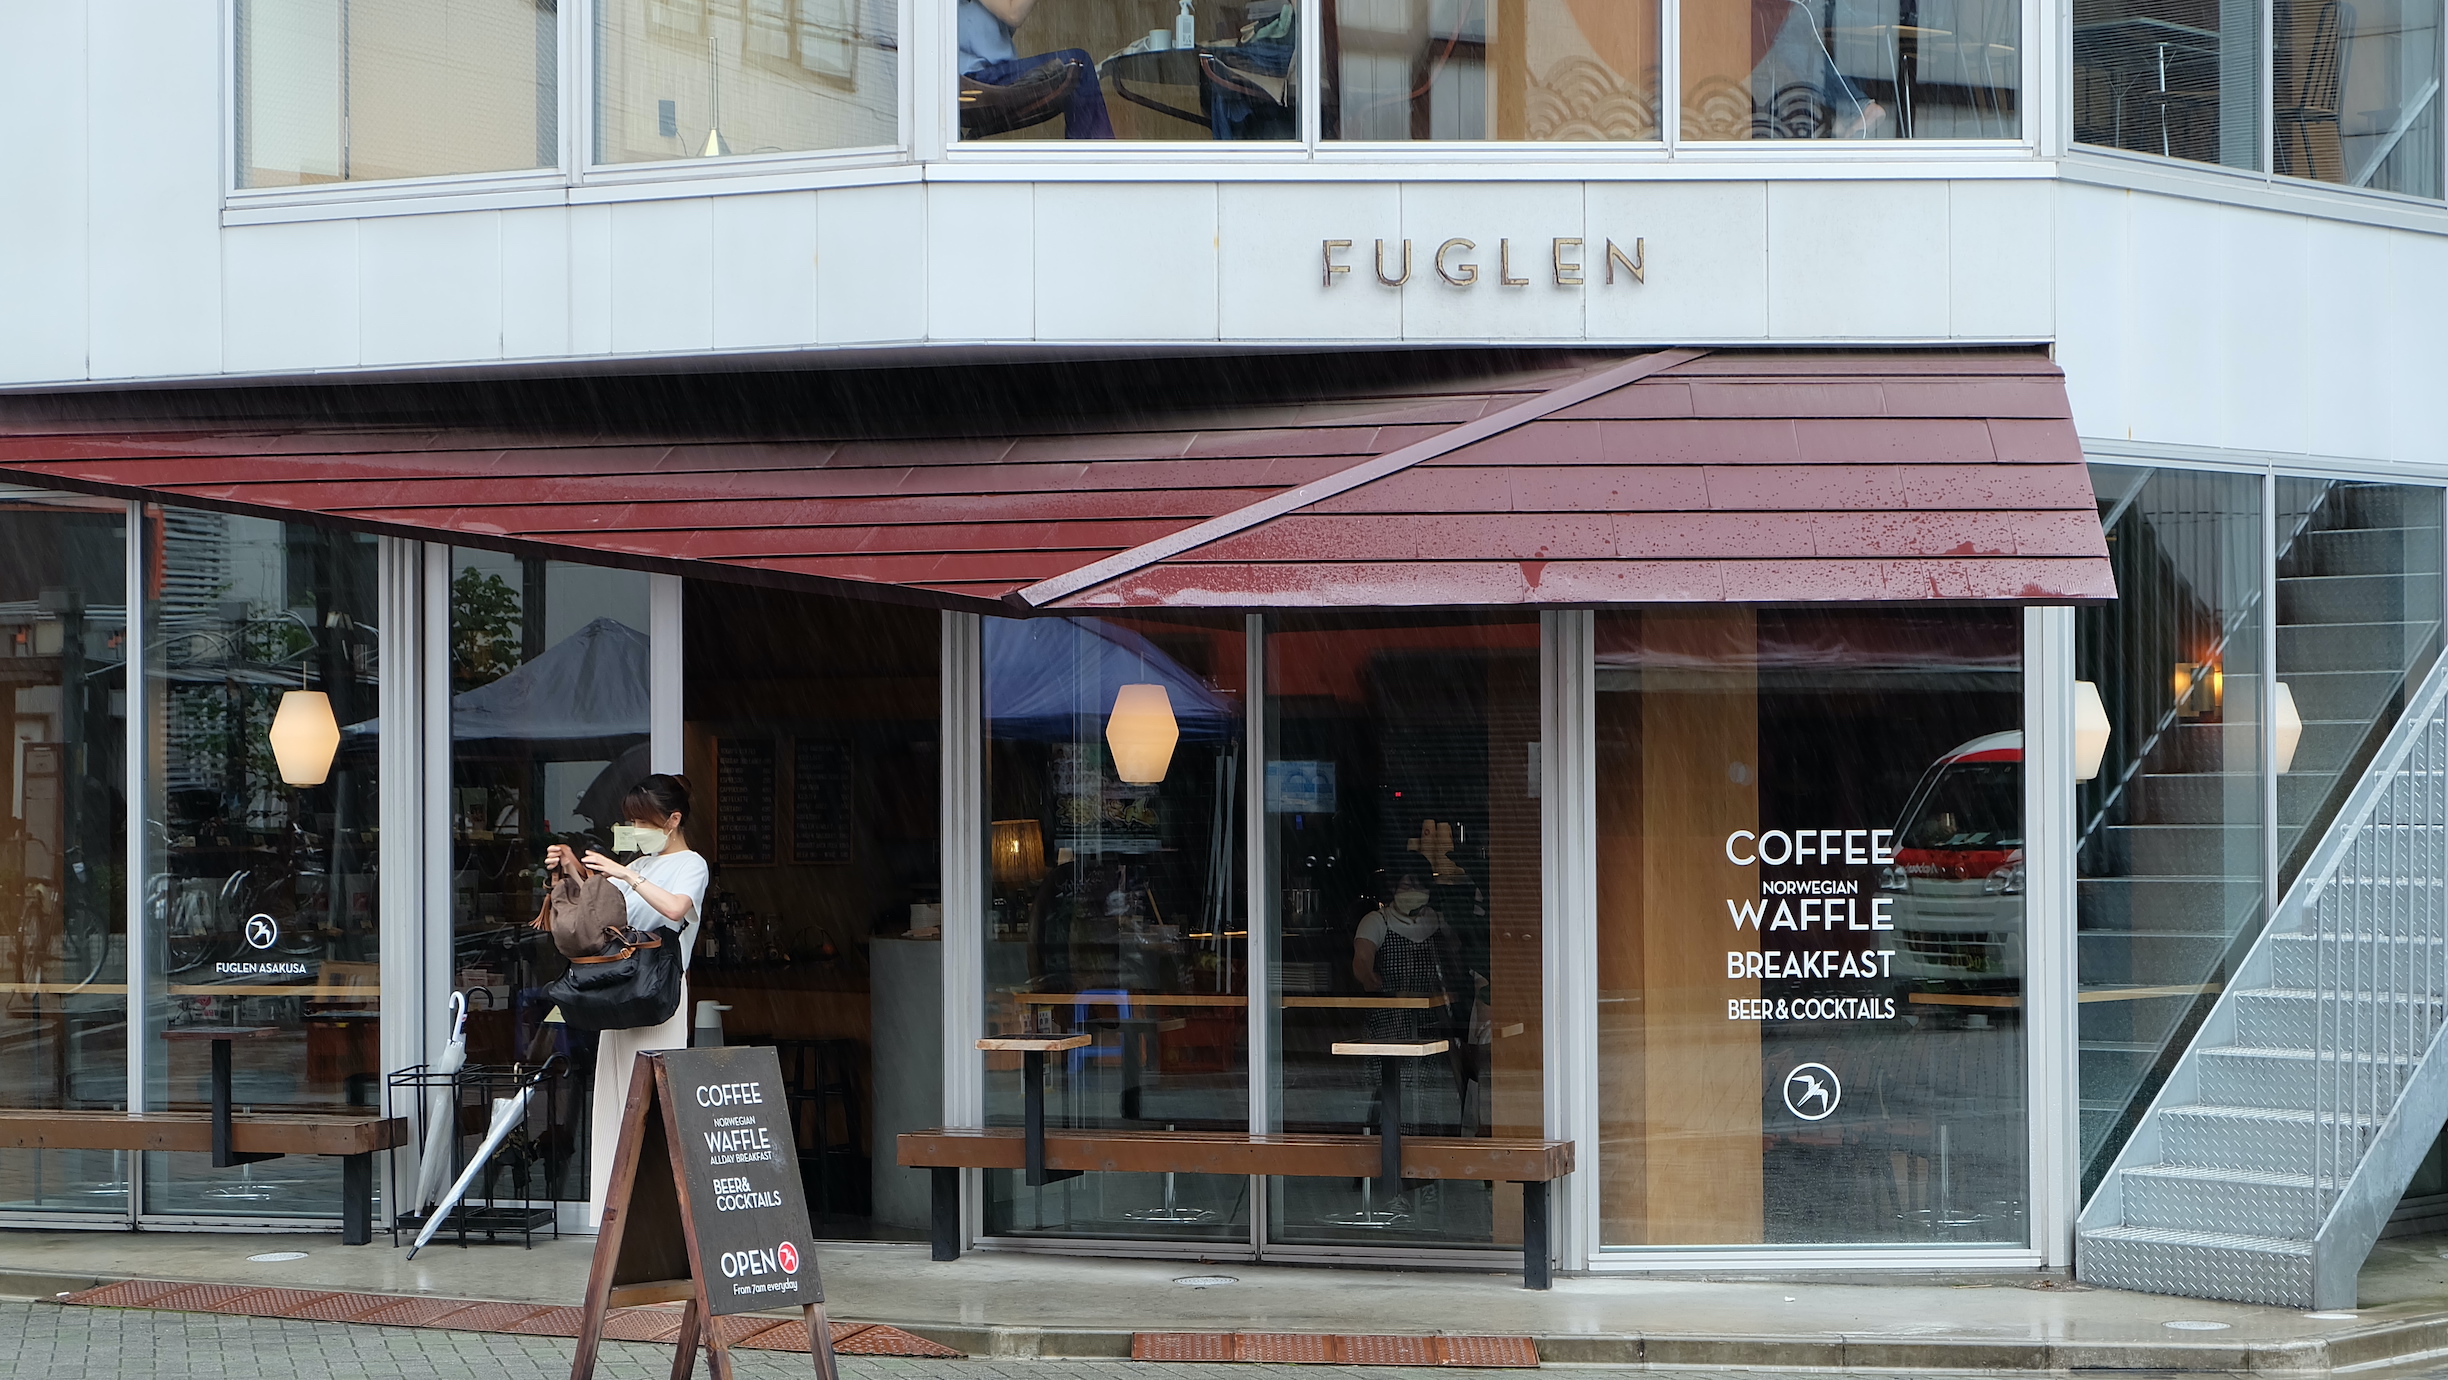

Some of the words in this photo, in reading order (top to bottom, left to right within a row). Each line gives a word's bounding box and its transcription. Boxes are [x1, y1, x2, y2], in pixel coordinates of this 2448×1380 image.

[1322, 237, 1645, 287] FUGLEN
[1725, 829, 1895, 866] COFFEE
[1762, 880, 1858, 895] NORWEGIAN
[1726, 898, 1895, 931] WAFFLE
[215, 962, 257, 973] FUGLEN
[259, 963, 307, 974] ASAKUSA
[1727, 950, 1896, 979] BREAKFAST
[696, 1082, 763, 1108] COFFEE
[713, 1116, 756, 1128] NORWEGIAN
[703, 1127, 771, 1153] WAFFLE
[735, 1151, 772, 1163] BREAKFAST
[716, 1190, 782, 1212] COCKTAILS
[720, 1248, 777, 1278] OPEN
[733, 1284, 751, 1296] From
[751, 1282, 767, 1295] 7am
[767, 1278, 798, 1294] everyday
